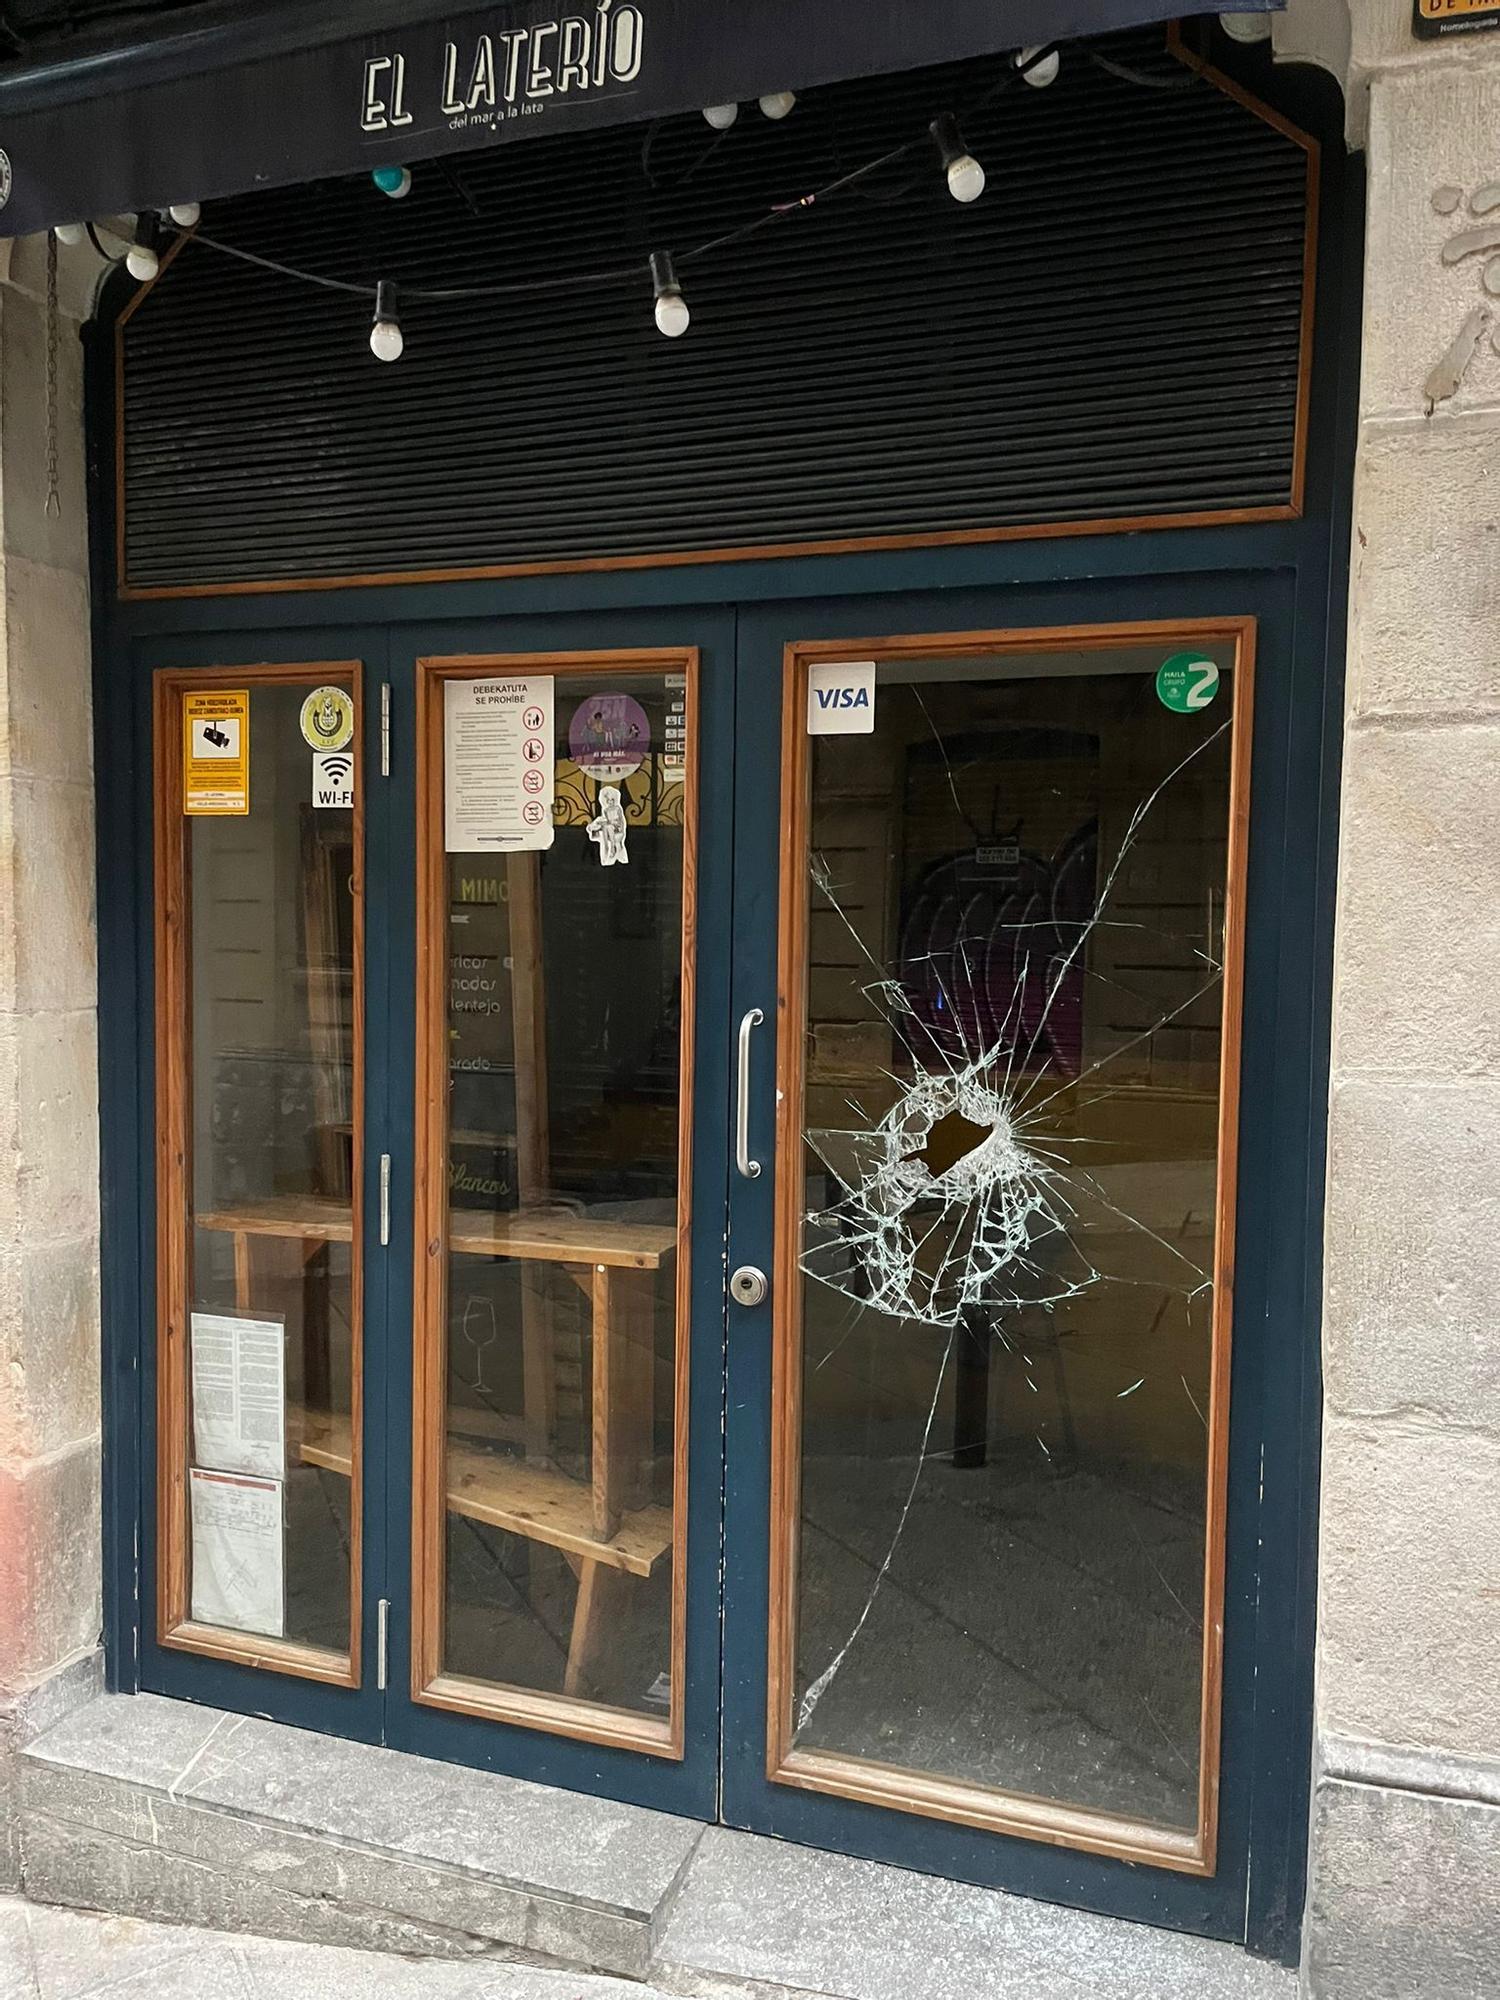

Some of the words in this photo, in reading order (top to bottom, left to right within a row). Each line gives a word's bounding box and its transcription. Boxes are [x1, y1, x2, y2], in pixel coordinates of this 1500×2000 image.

[361, 53, 413, 131] EL
[441, 0, 644, 115] LATERÍO
[449, 114, 468, 130] del
[470, 112, 494, 126] mar
[497, 111, 505, 121] a
[507, 105, 518, 118] la
[521, 102, 544, 115] lata
[473, 684, 528, 694] DEBEKATUTA
[1187, 661, 1219, 707] 2
[475, 697, 486, 705] SE
[813, 688, 869, 709] VISA
[319, 791, 354, 804] WI-FI
